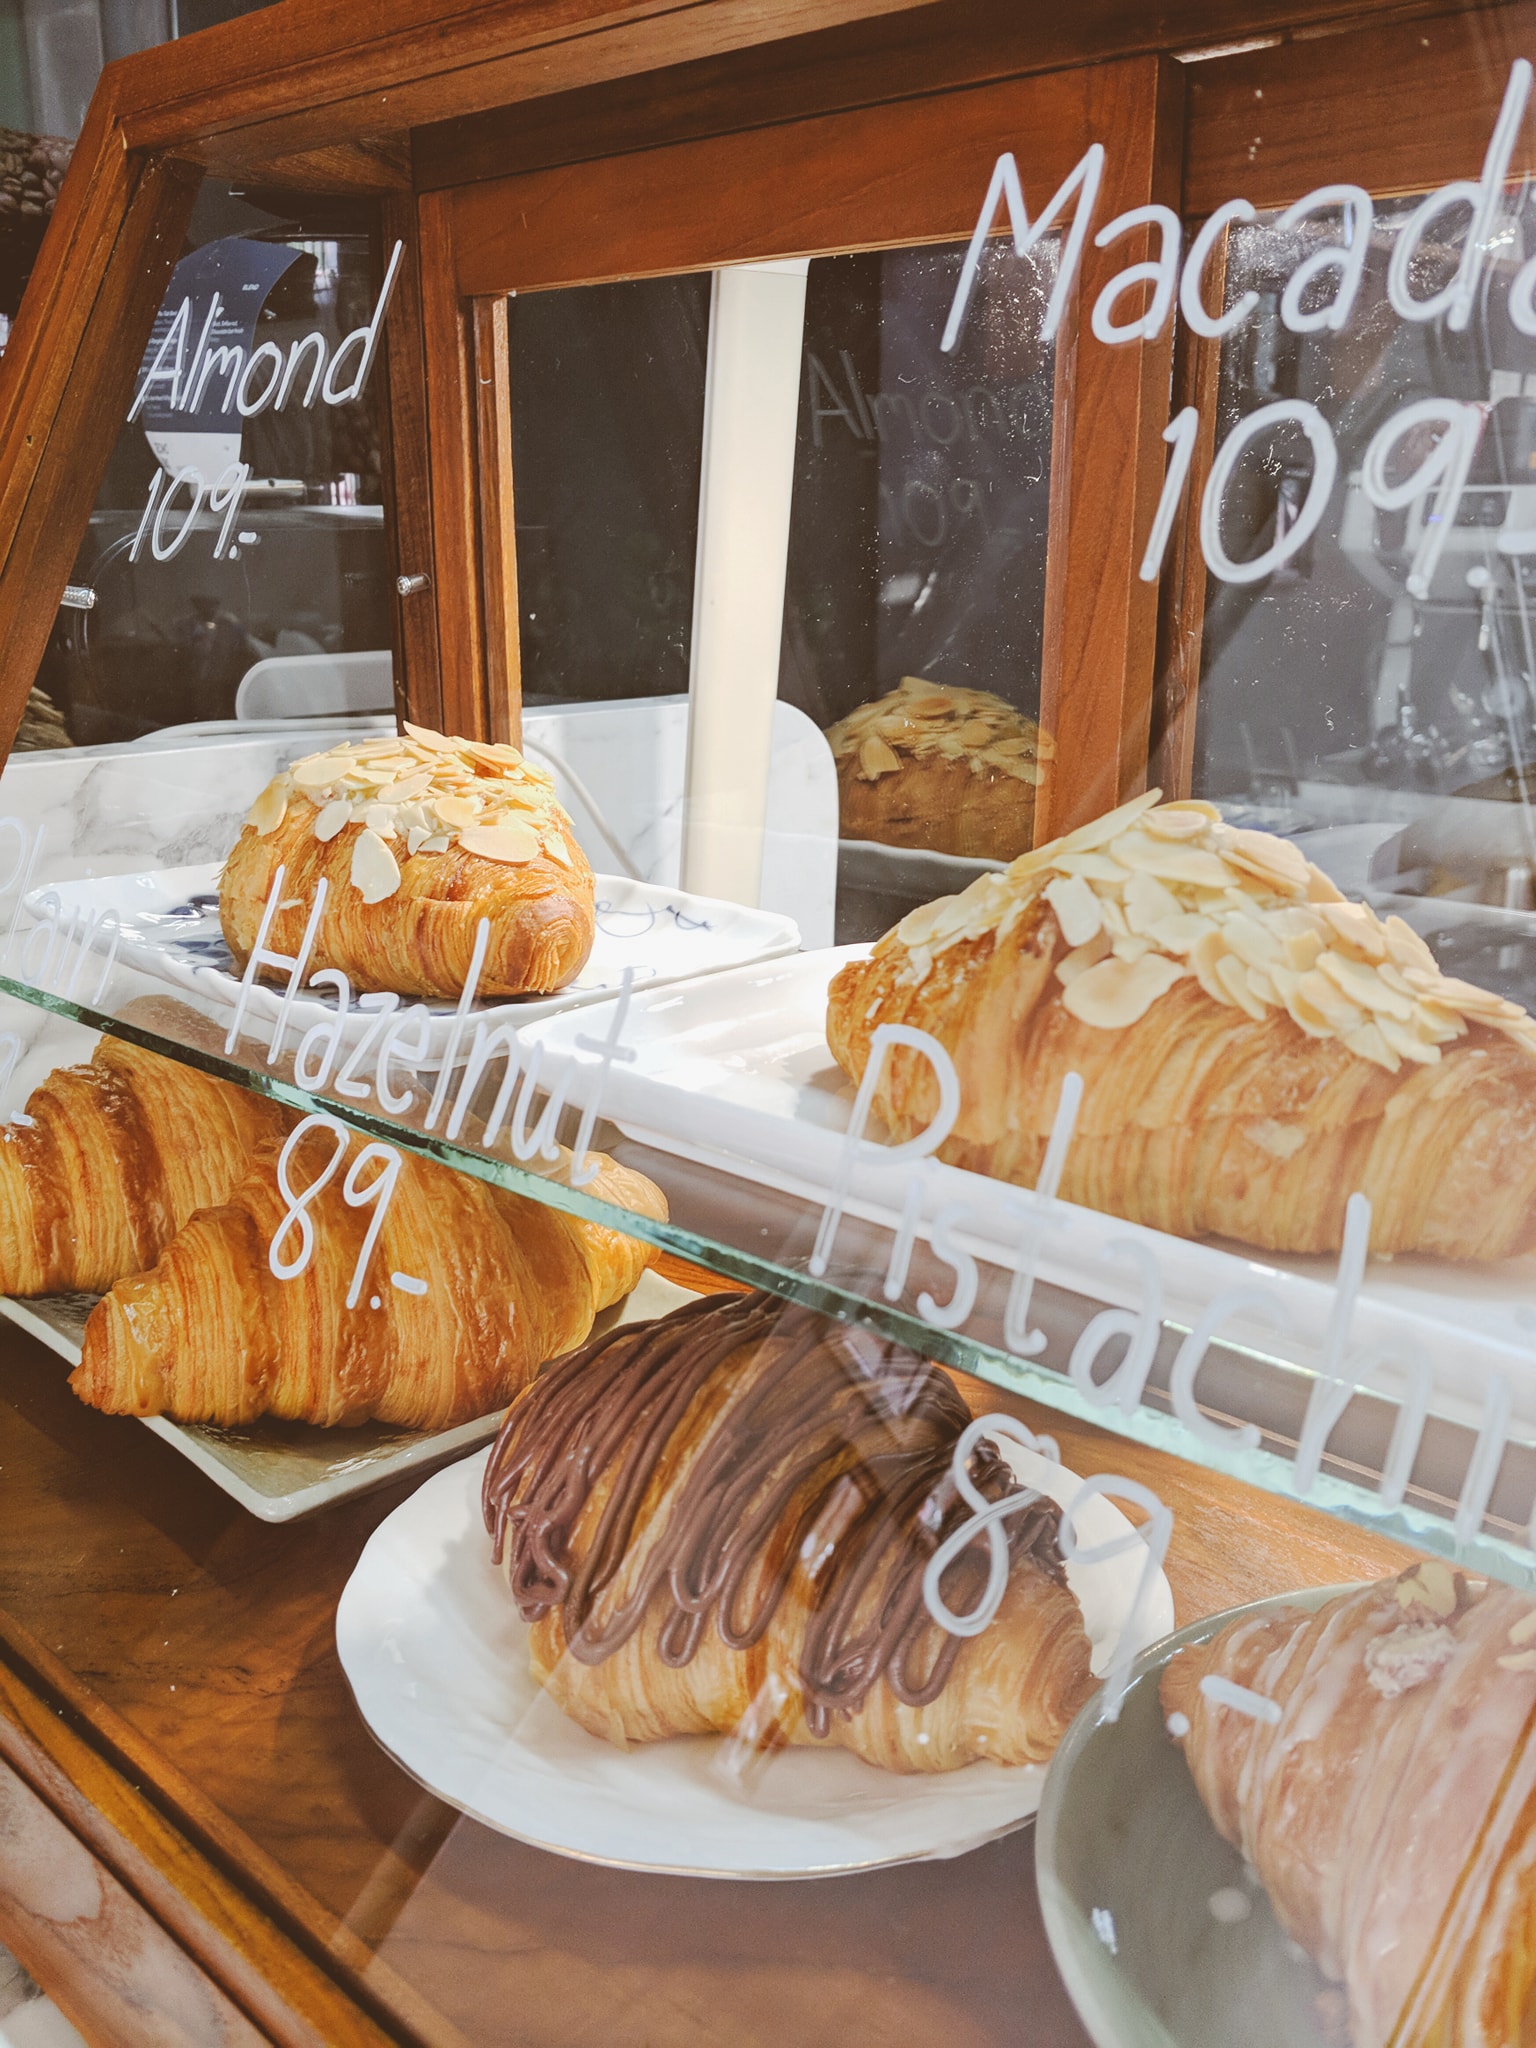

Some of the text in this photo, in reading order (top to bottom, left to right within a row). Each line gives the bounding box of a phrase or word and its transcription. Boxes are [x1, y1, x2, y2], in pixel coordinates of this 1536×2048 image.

[126, 239, 403, 424] Almond
[224, 863, 638, 1187] Hazelnut
[810, 1022, 1536, 1546] Pistachi
